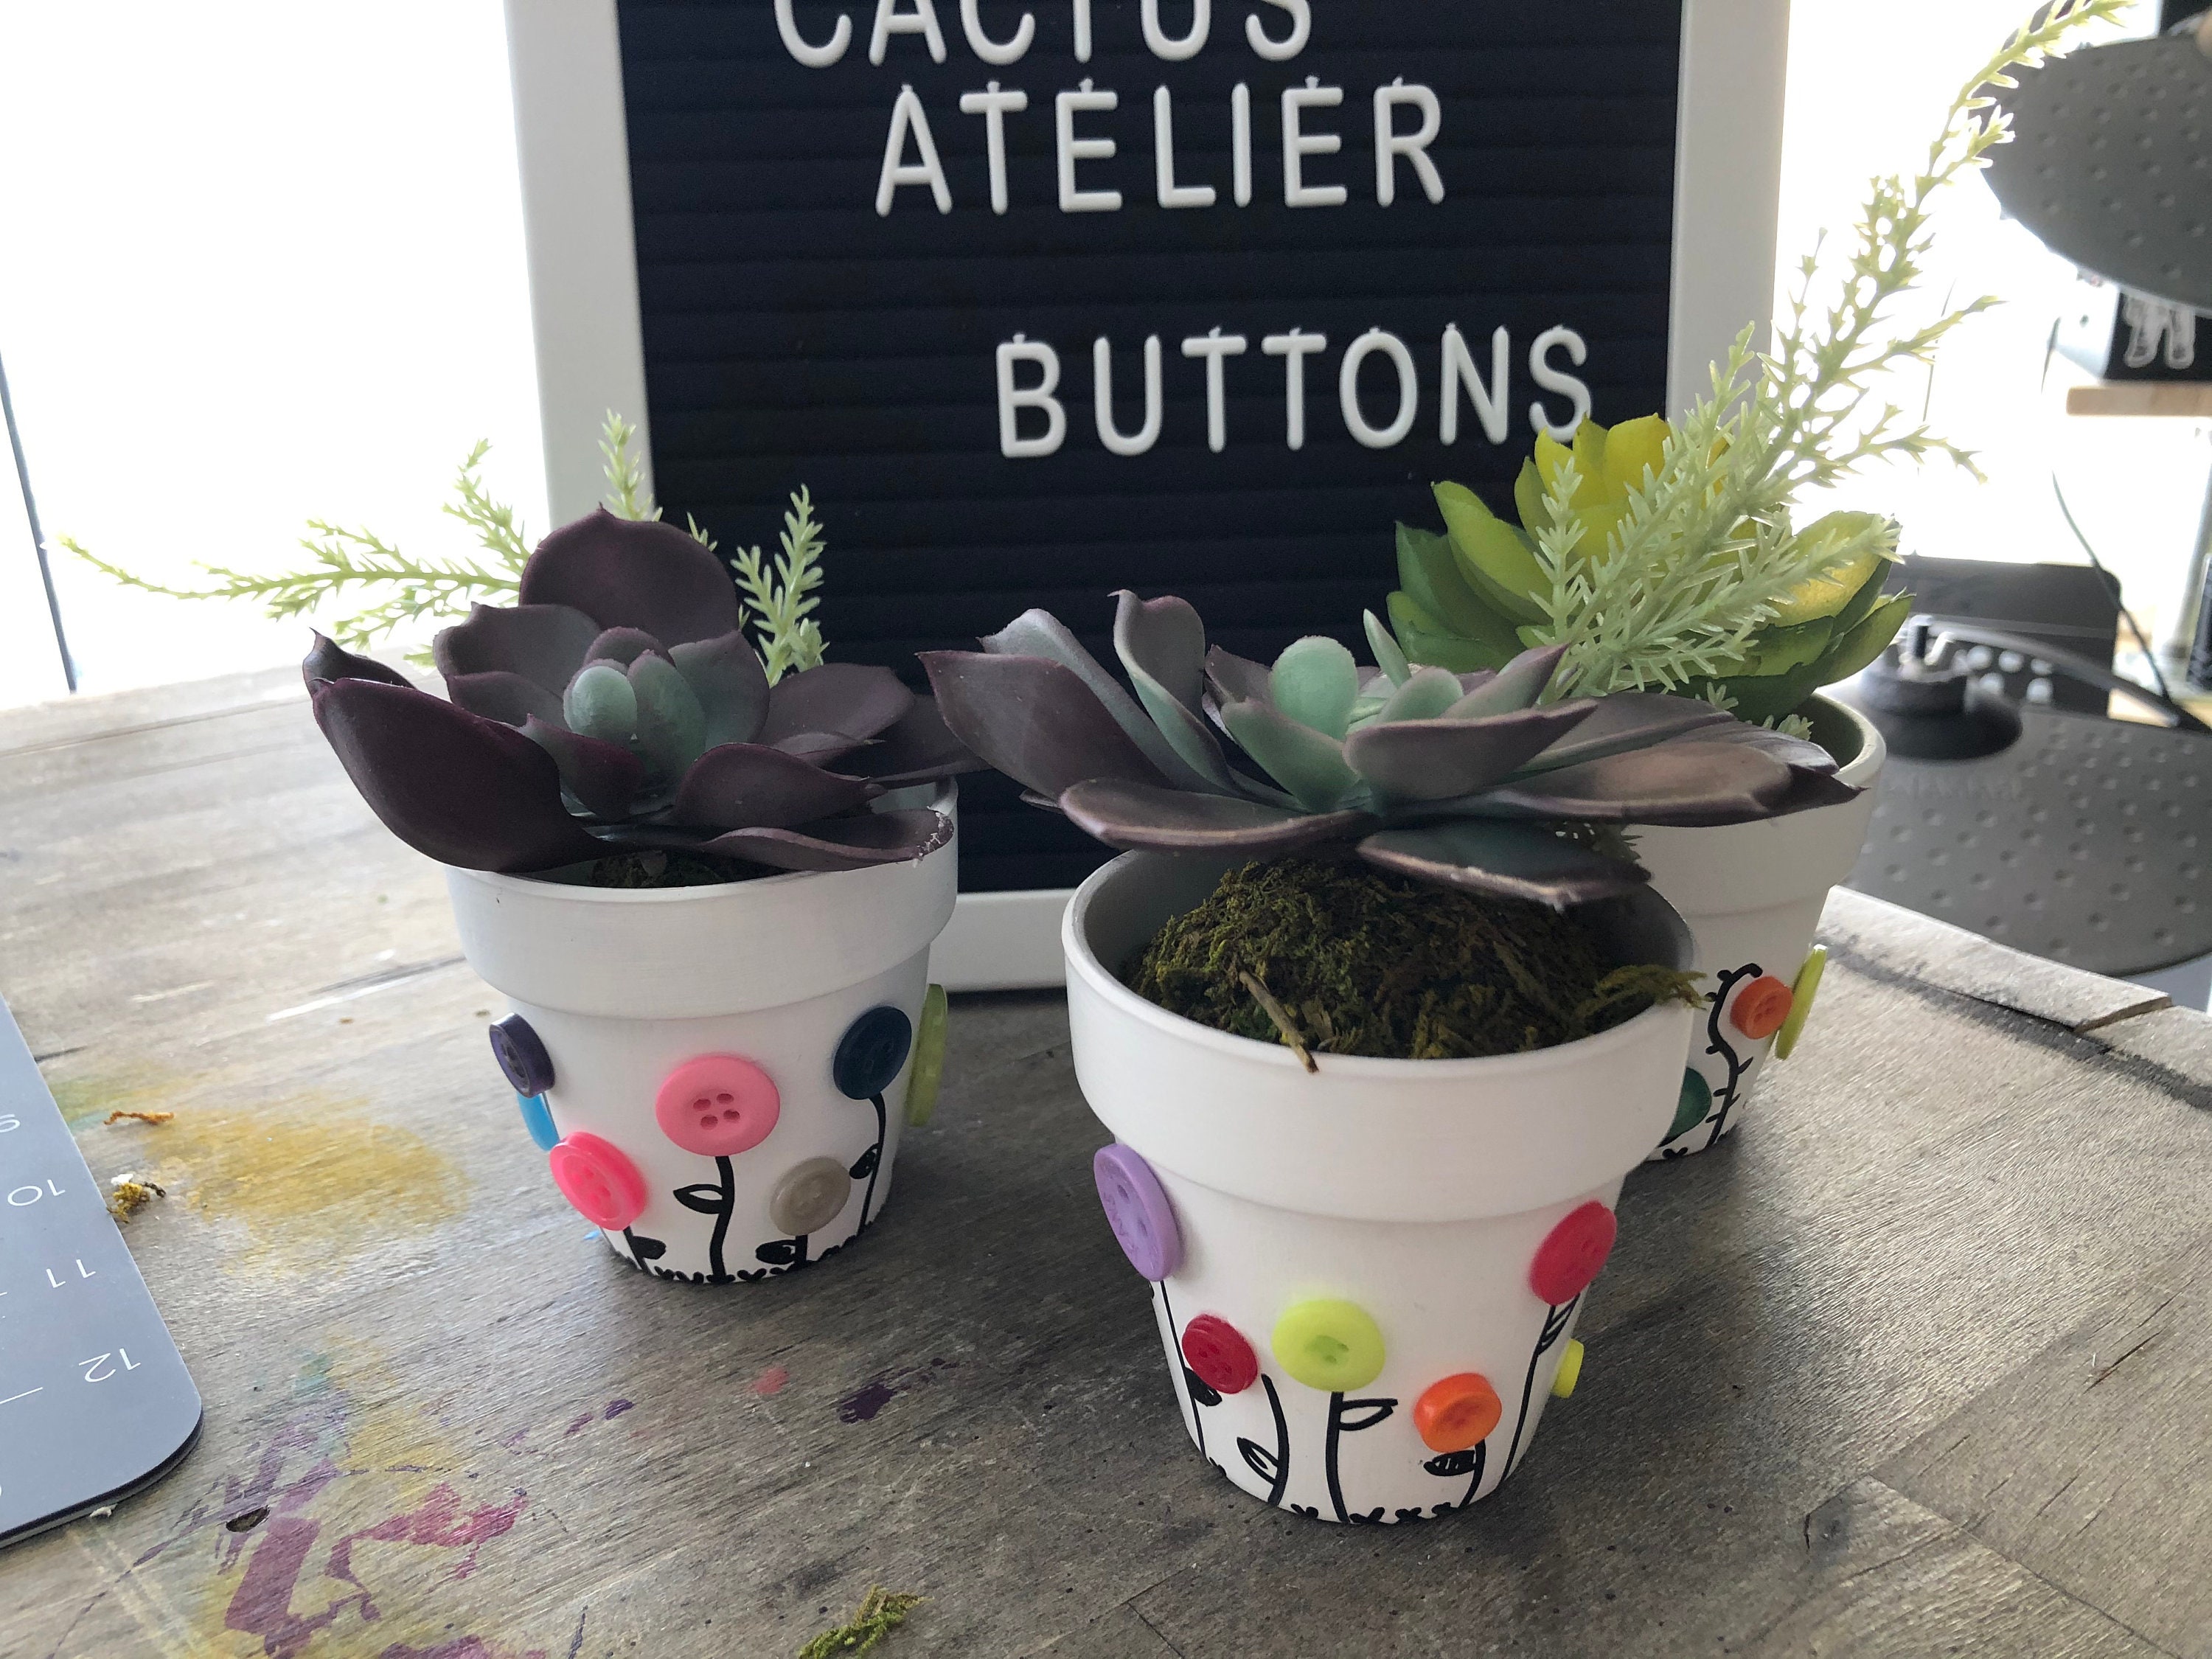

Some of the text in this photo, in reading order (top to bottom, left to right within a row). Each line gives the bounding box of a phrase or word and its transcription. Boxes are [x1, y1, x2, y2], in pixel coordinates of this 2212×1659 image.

[874, 76, 1444, 215] ATELIER
[995, 323, 1591, 457] BUTTONS
[7, 1178, 66, 1206] 10
[46, 1259, 97, 1288] 11
[78, 1348, 142, 1382] 12
